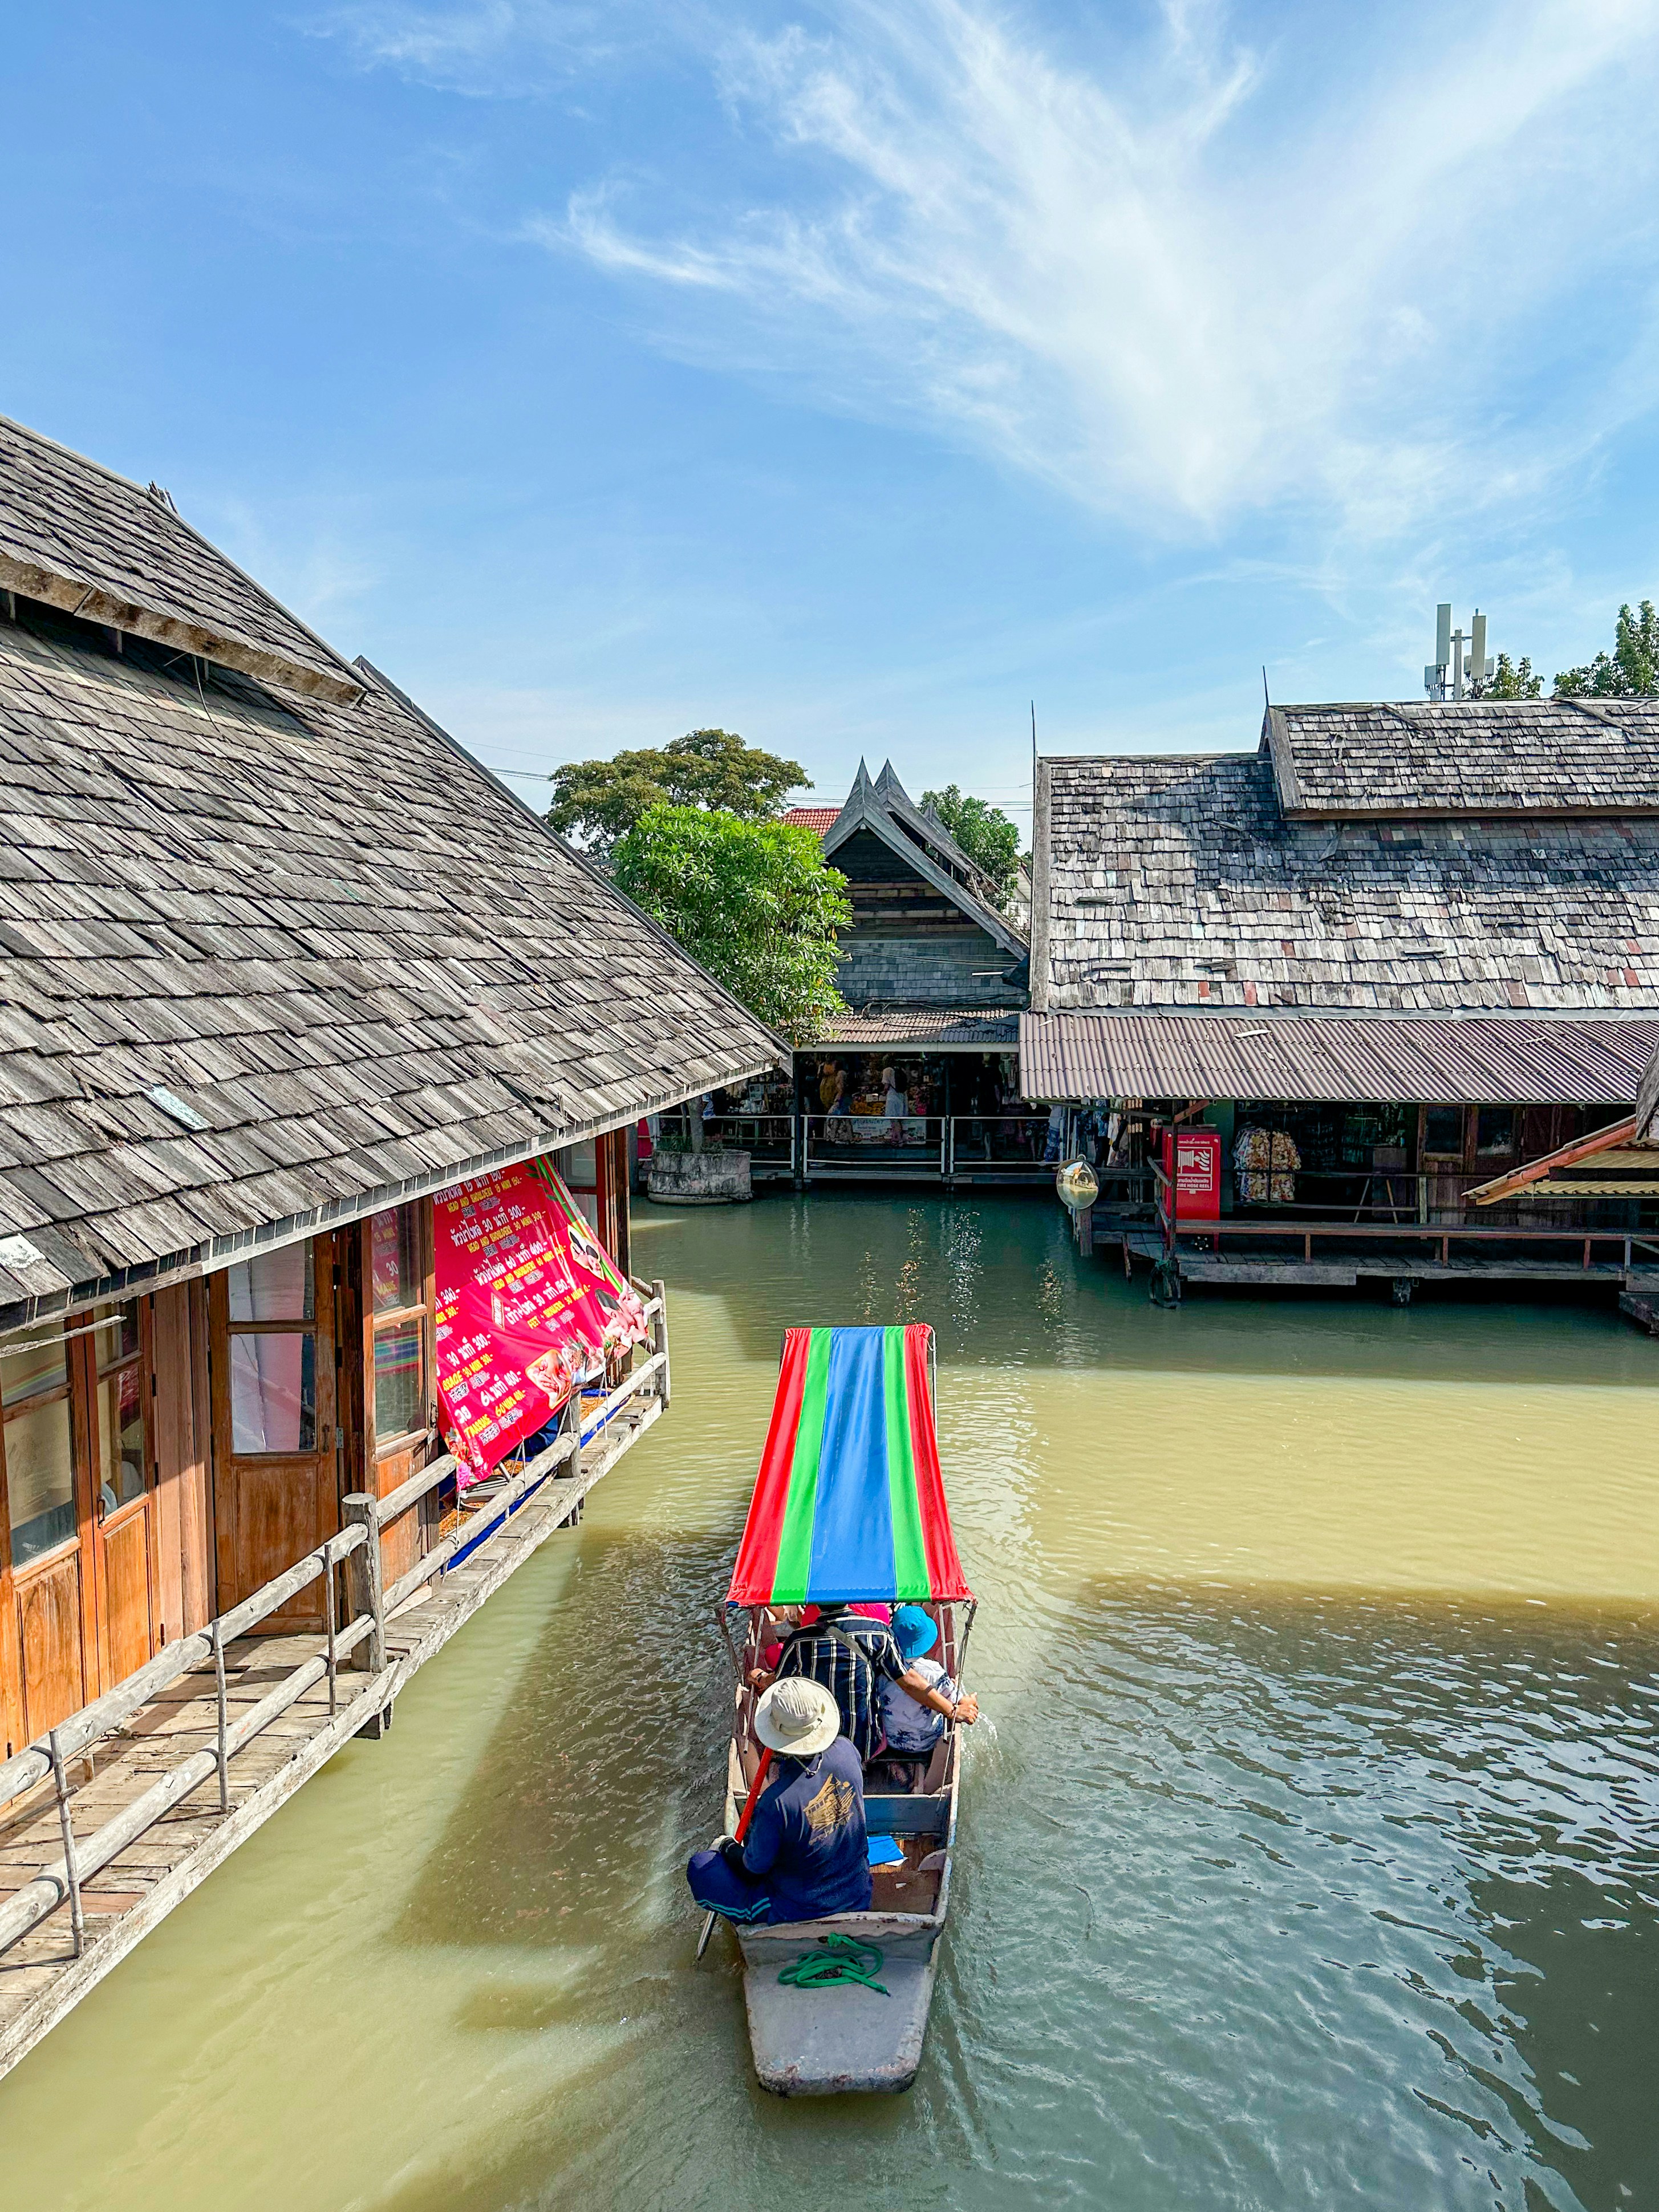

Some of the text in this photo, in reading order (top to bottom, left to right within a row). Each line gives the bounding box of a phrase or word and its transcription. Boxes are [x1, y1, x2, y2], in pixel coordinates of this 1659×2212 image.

[481, 1217, 494, 1233] 30
[513, 1220, 521, 1231] 30
[504, 1255, 517, 1270] 60
[532, 1292, 546, 1307] 30
[526, 1315, 541, 1330] FEET
[446, 1351, 460, 1367] 30
[461, 1366, 473, 1378] 30
